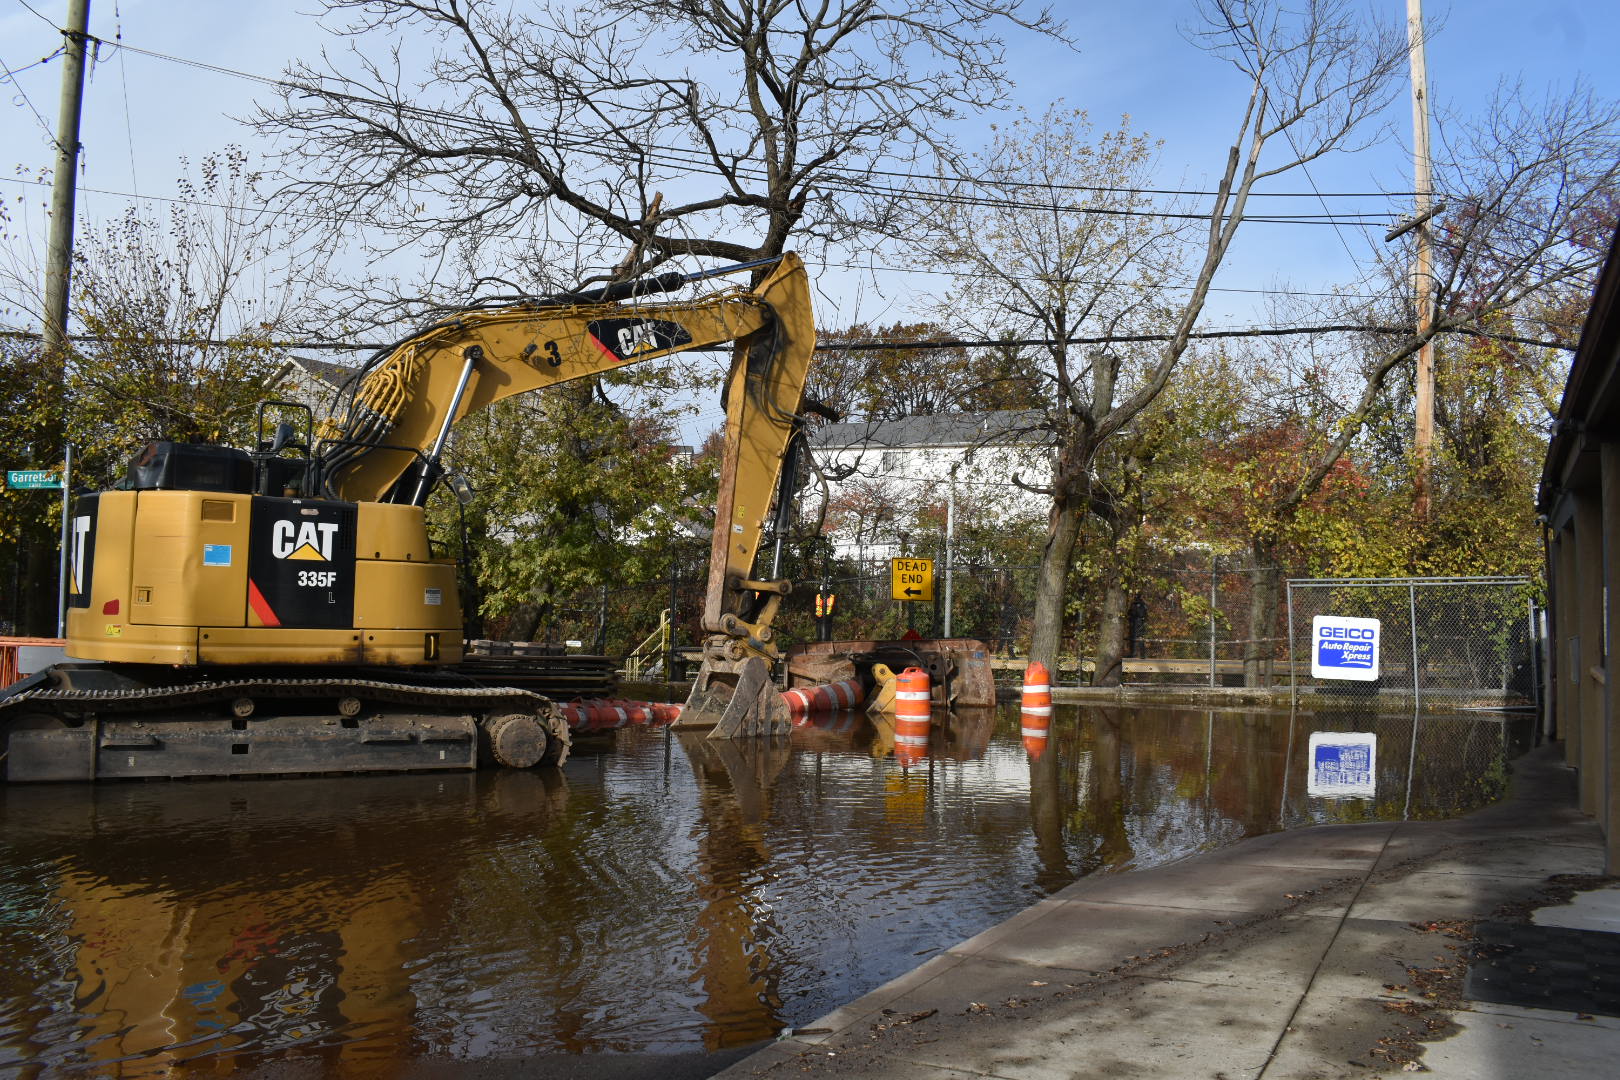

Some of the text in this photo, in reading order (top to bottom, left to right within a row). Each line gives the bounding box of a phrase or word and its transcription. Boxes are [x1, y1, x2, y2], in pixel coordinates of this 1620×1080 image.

[617, 321, 659, 356] CAT
[544, 340, 562, 368] 3
[272, 519, 339, 562] CAT
[897, 561, 927, 572] DEAD
[297, 570, 337, 588] 335F
[901, 573, 923, 584] END
[328, 591, 336, 604] L
[1319, 626, 1375, 640] GEICO
[1321, 641, 1371, 653] Auto Repair
[1341, 650, 1371, 661] Xpress
